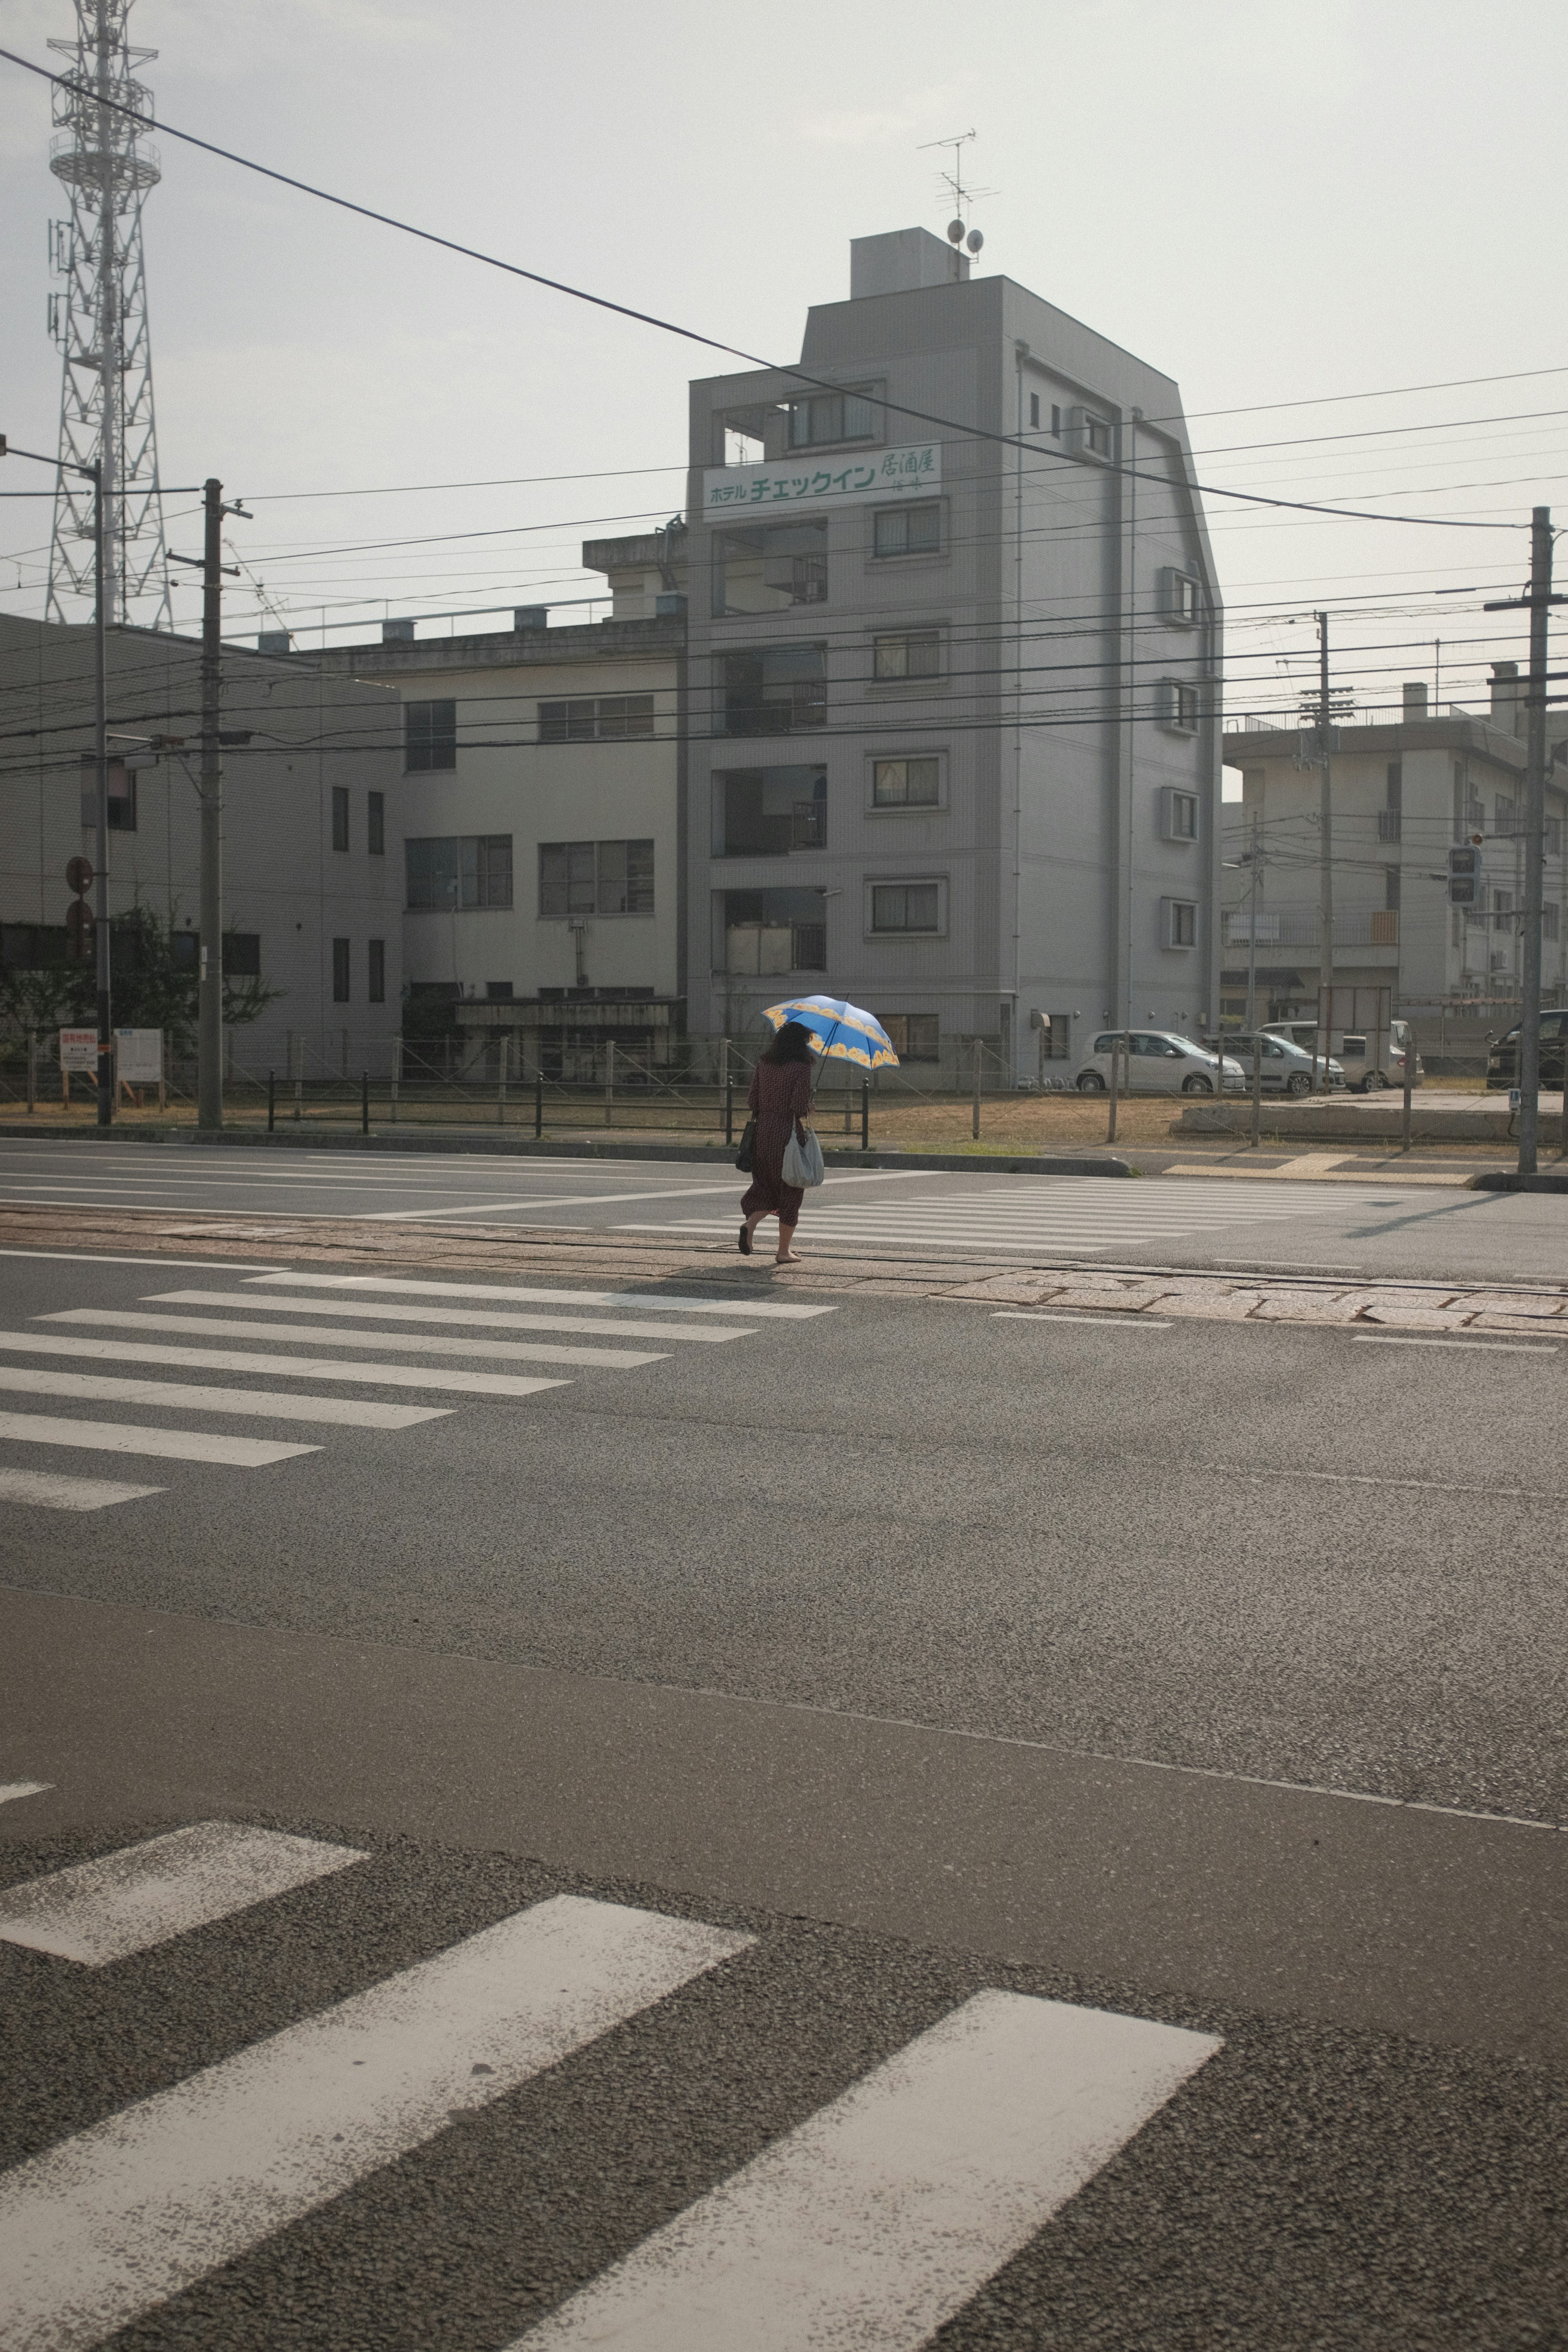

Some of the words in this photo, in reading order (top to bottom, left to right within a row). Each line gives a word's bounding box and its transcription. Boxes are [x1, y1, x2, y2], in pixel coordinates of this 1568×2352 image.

[881, 448, 935, 476] 居酒屋
[710, 485, 747, 503] ホテル
[750, 467, 876, 502] チェックイン
